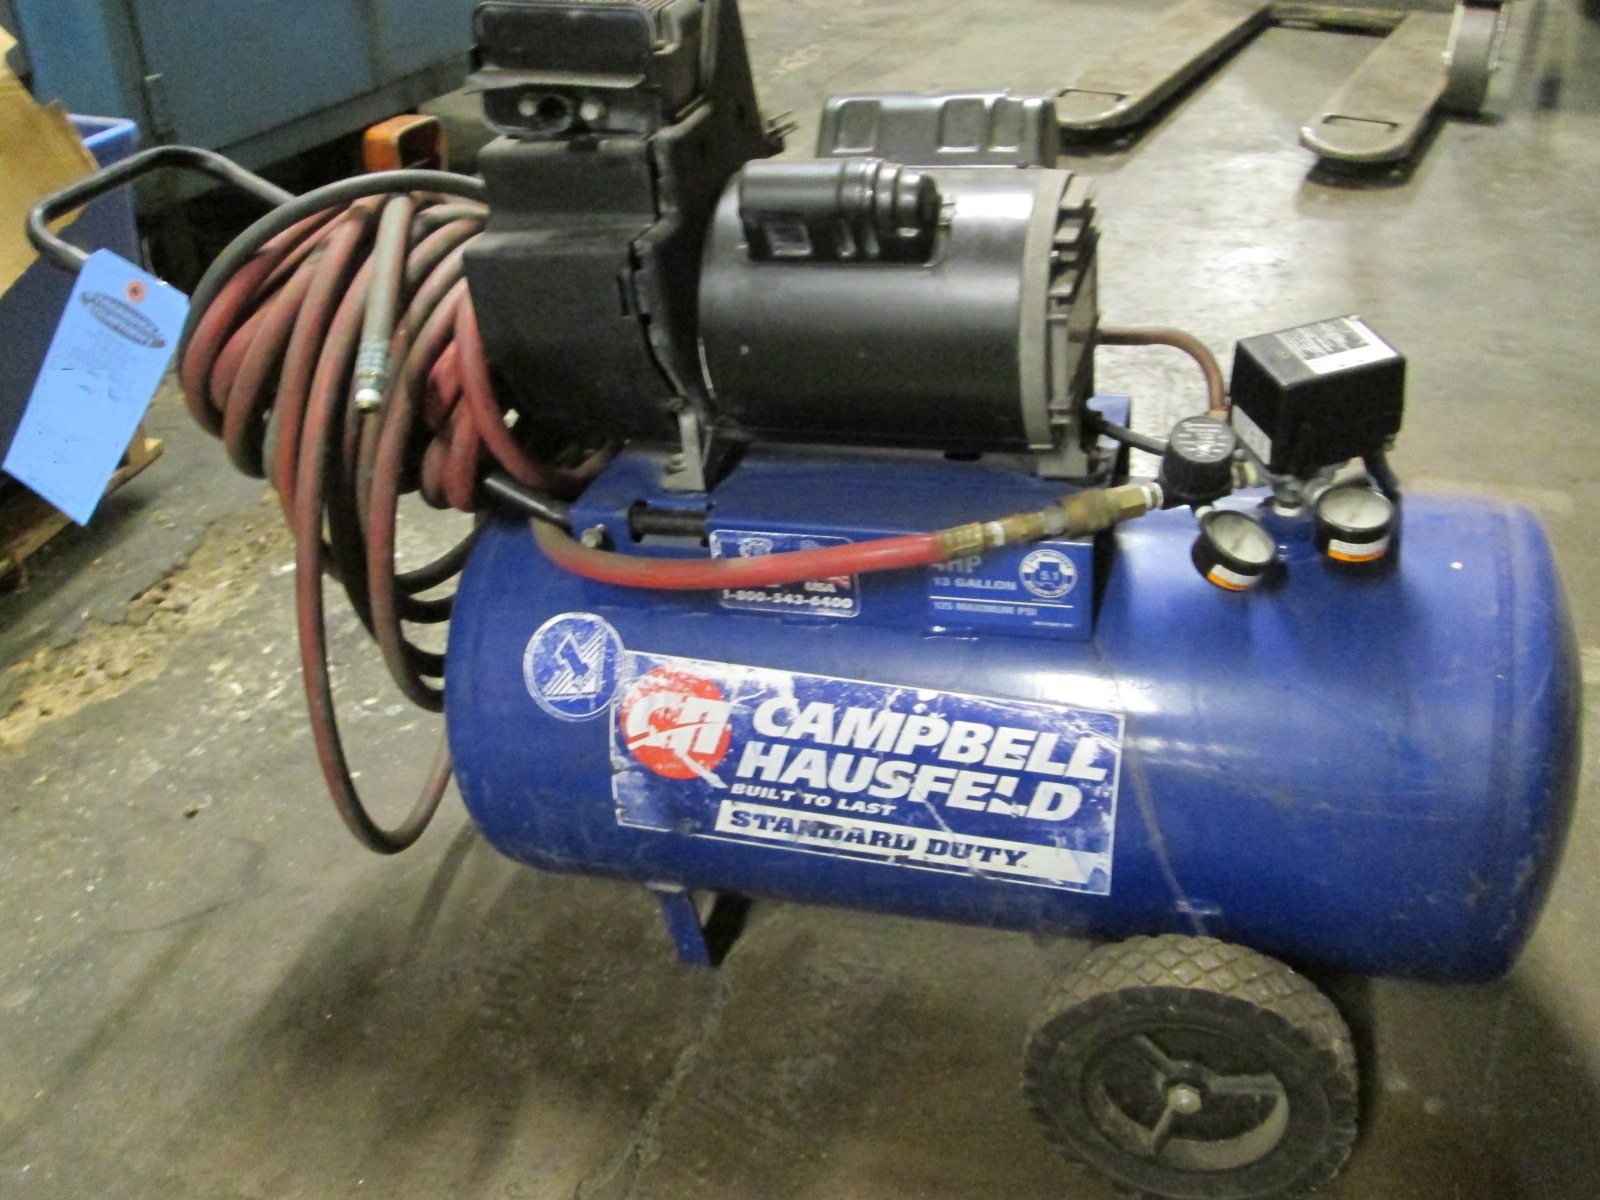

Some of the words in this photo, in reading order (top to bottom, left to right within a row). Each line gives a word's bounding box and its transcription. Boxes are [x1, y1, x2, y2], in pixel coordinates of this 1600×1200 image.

[954, 578, 1017, 591] GALLON
[752, 697, 1108, 781] CAMPBELL
[730, 783, 797, 802] BUILT
[803, 790, 832, 808] TO
[837, 797, 898, 817] LAST
[735, 741, 1083, 822] HAUSFELD
[730, 809, 917, 852] STANDARD
[926, 836, 1026, 868] DUTY
